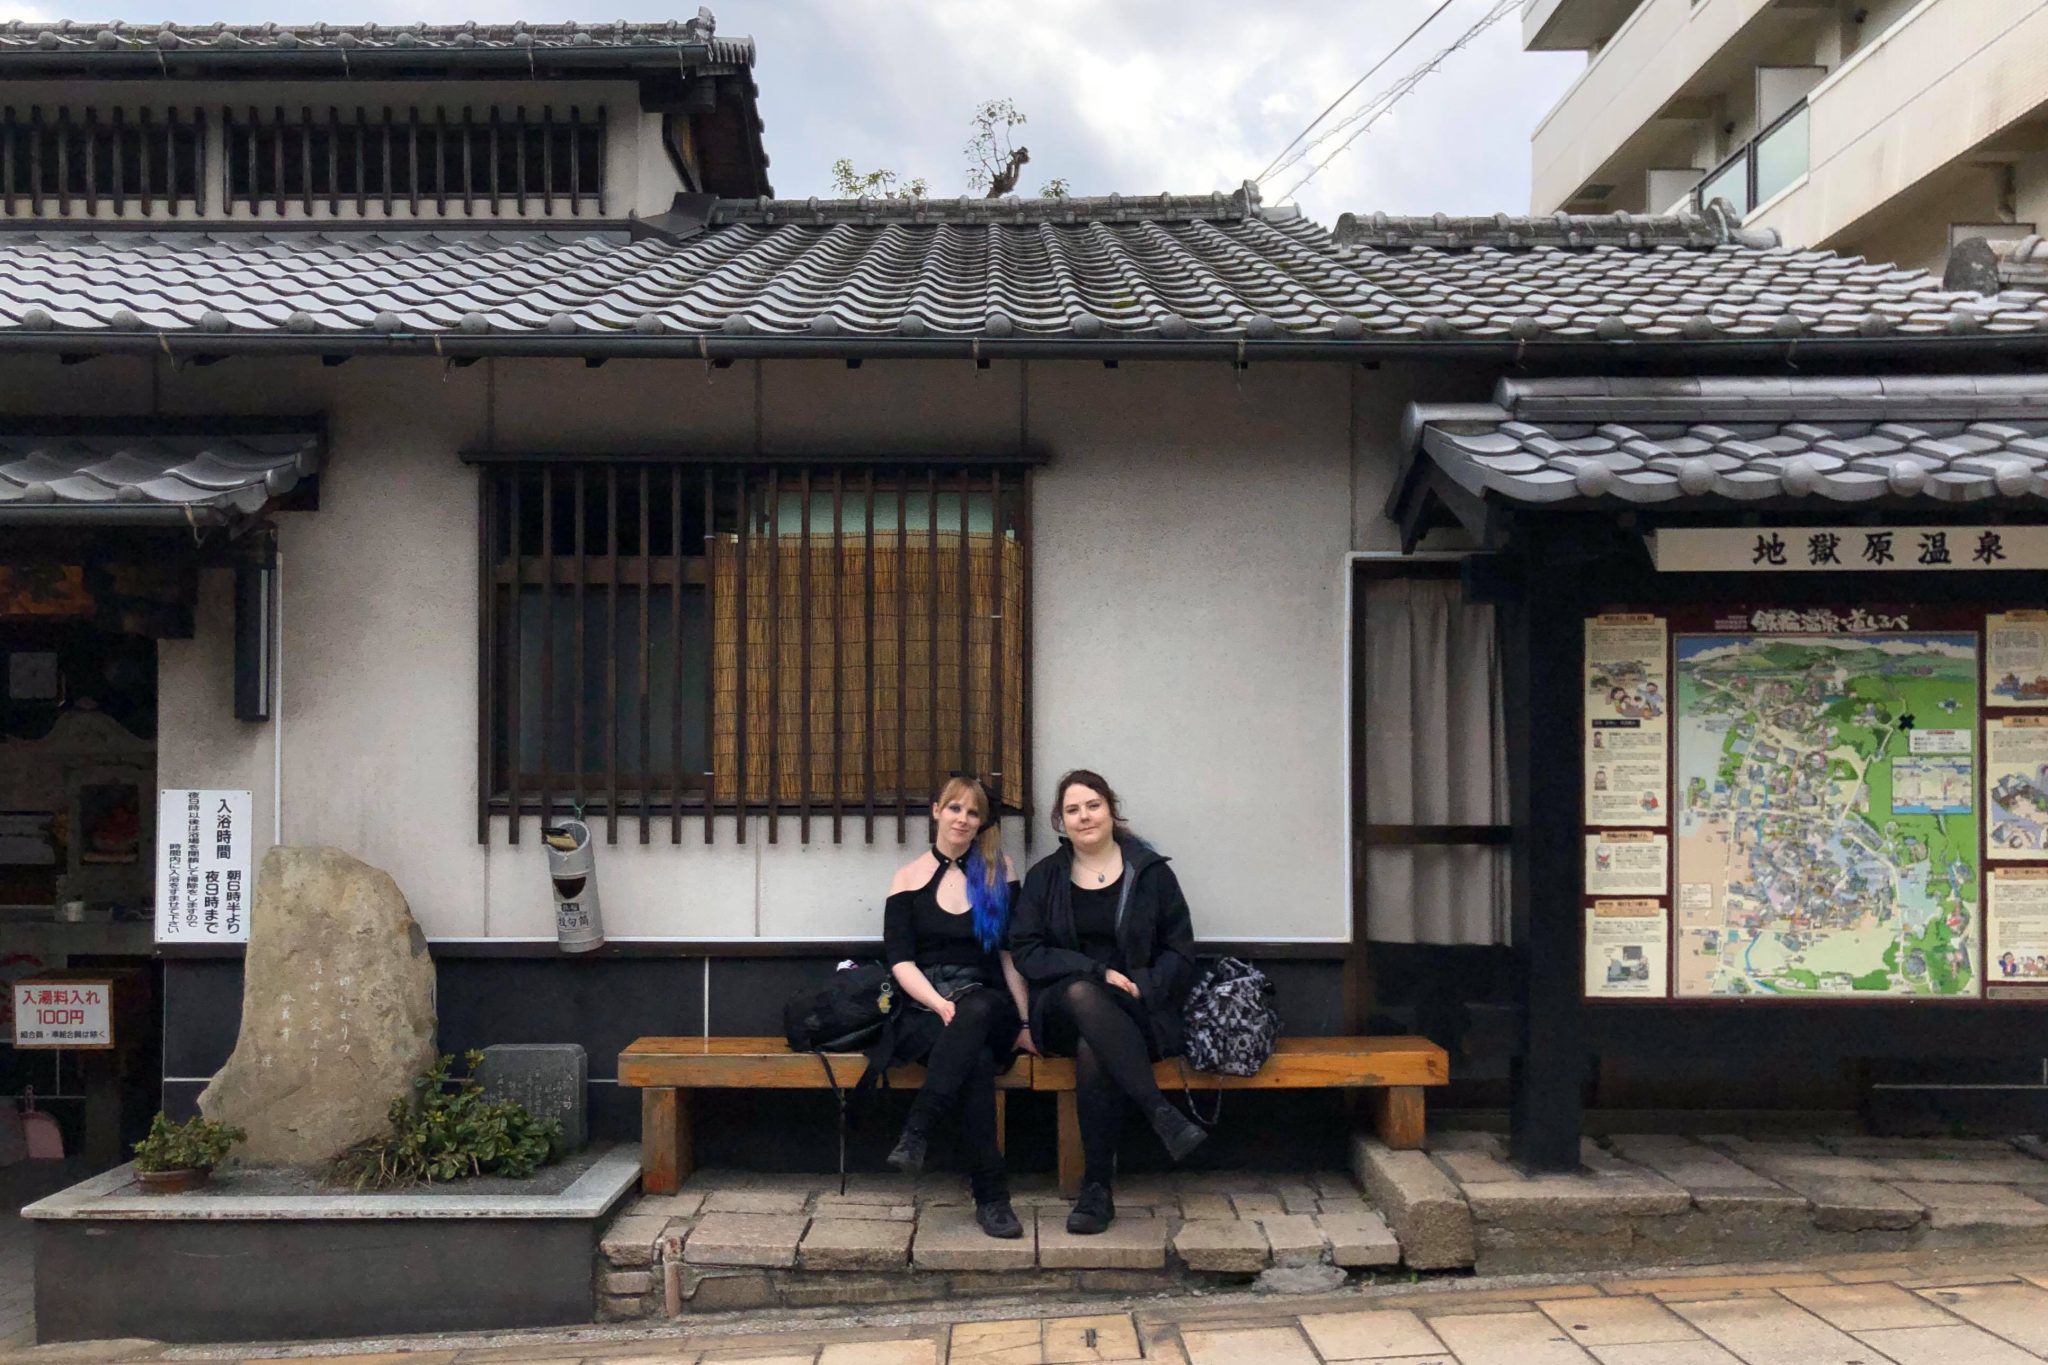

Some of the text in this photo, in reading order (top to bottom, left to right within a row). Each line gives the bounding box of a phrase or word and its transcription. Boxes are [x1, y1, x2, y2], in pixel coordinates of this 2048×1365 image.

[1752, 531, 2007, 566] 地獄原温泉
[216, 798, 232, 860] 入浴時間
[204, 870, 220, 934] 夜9時まで
[226, 870, 242, 934] 朝6時半より
[22, 989, 101, 1005] 入湯料入れ
[37, 1009, 85, 1025] 100円
